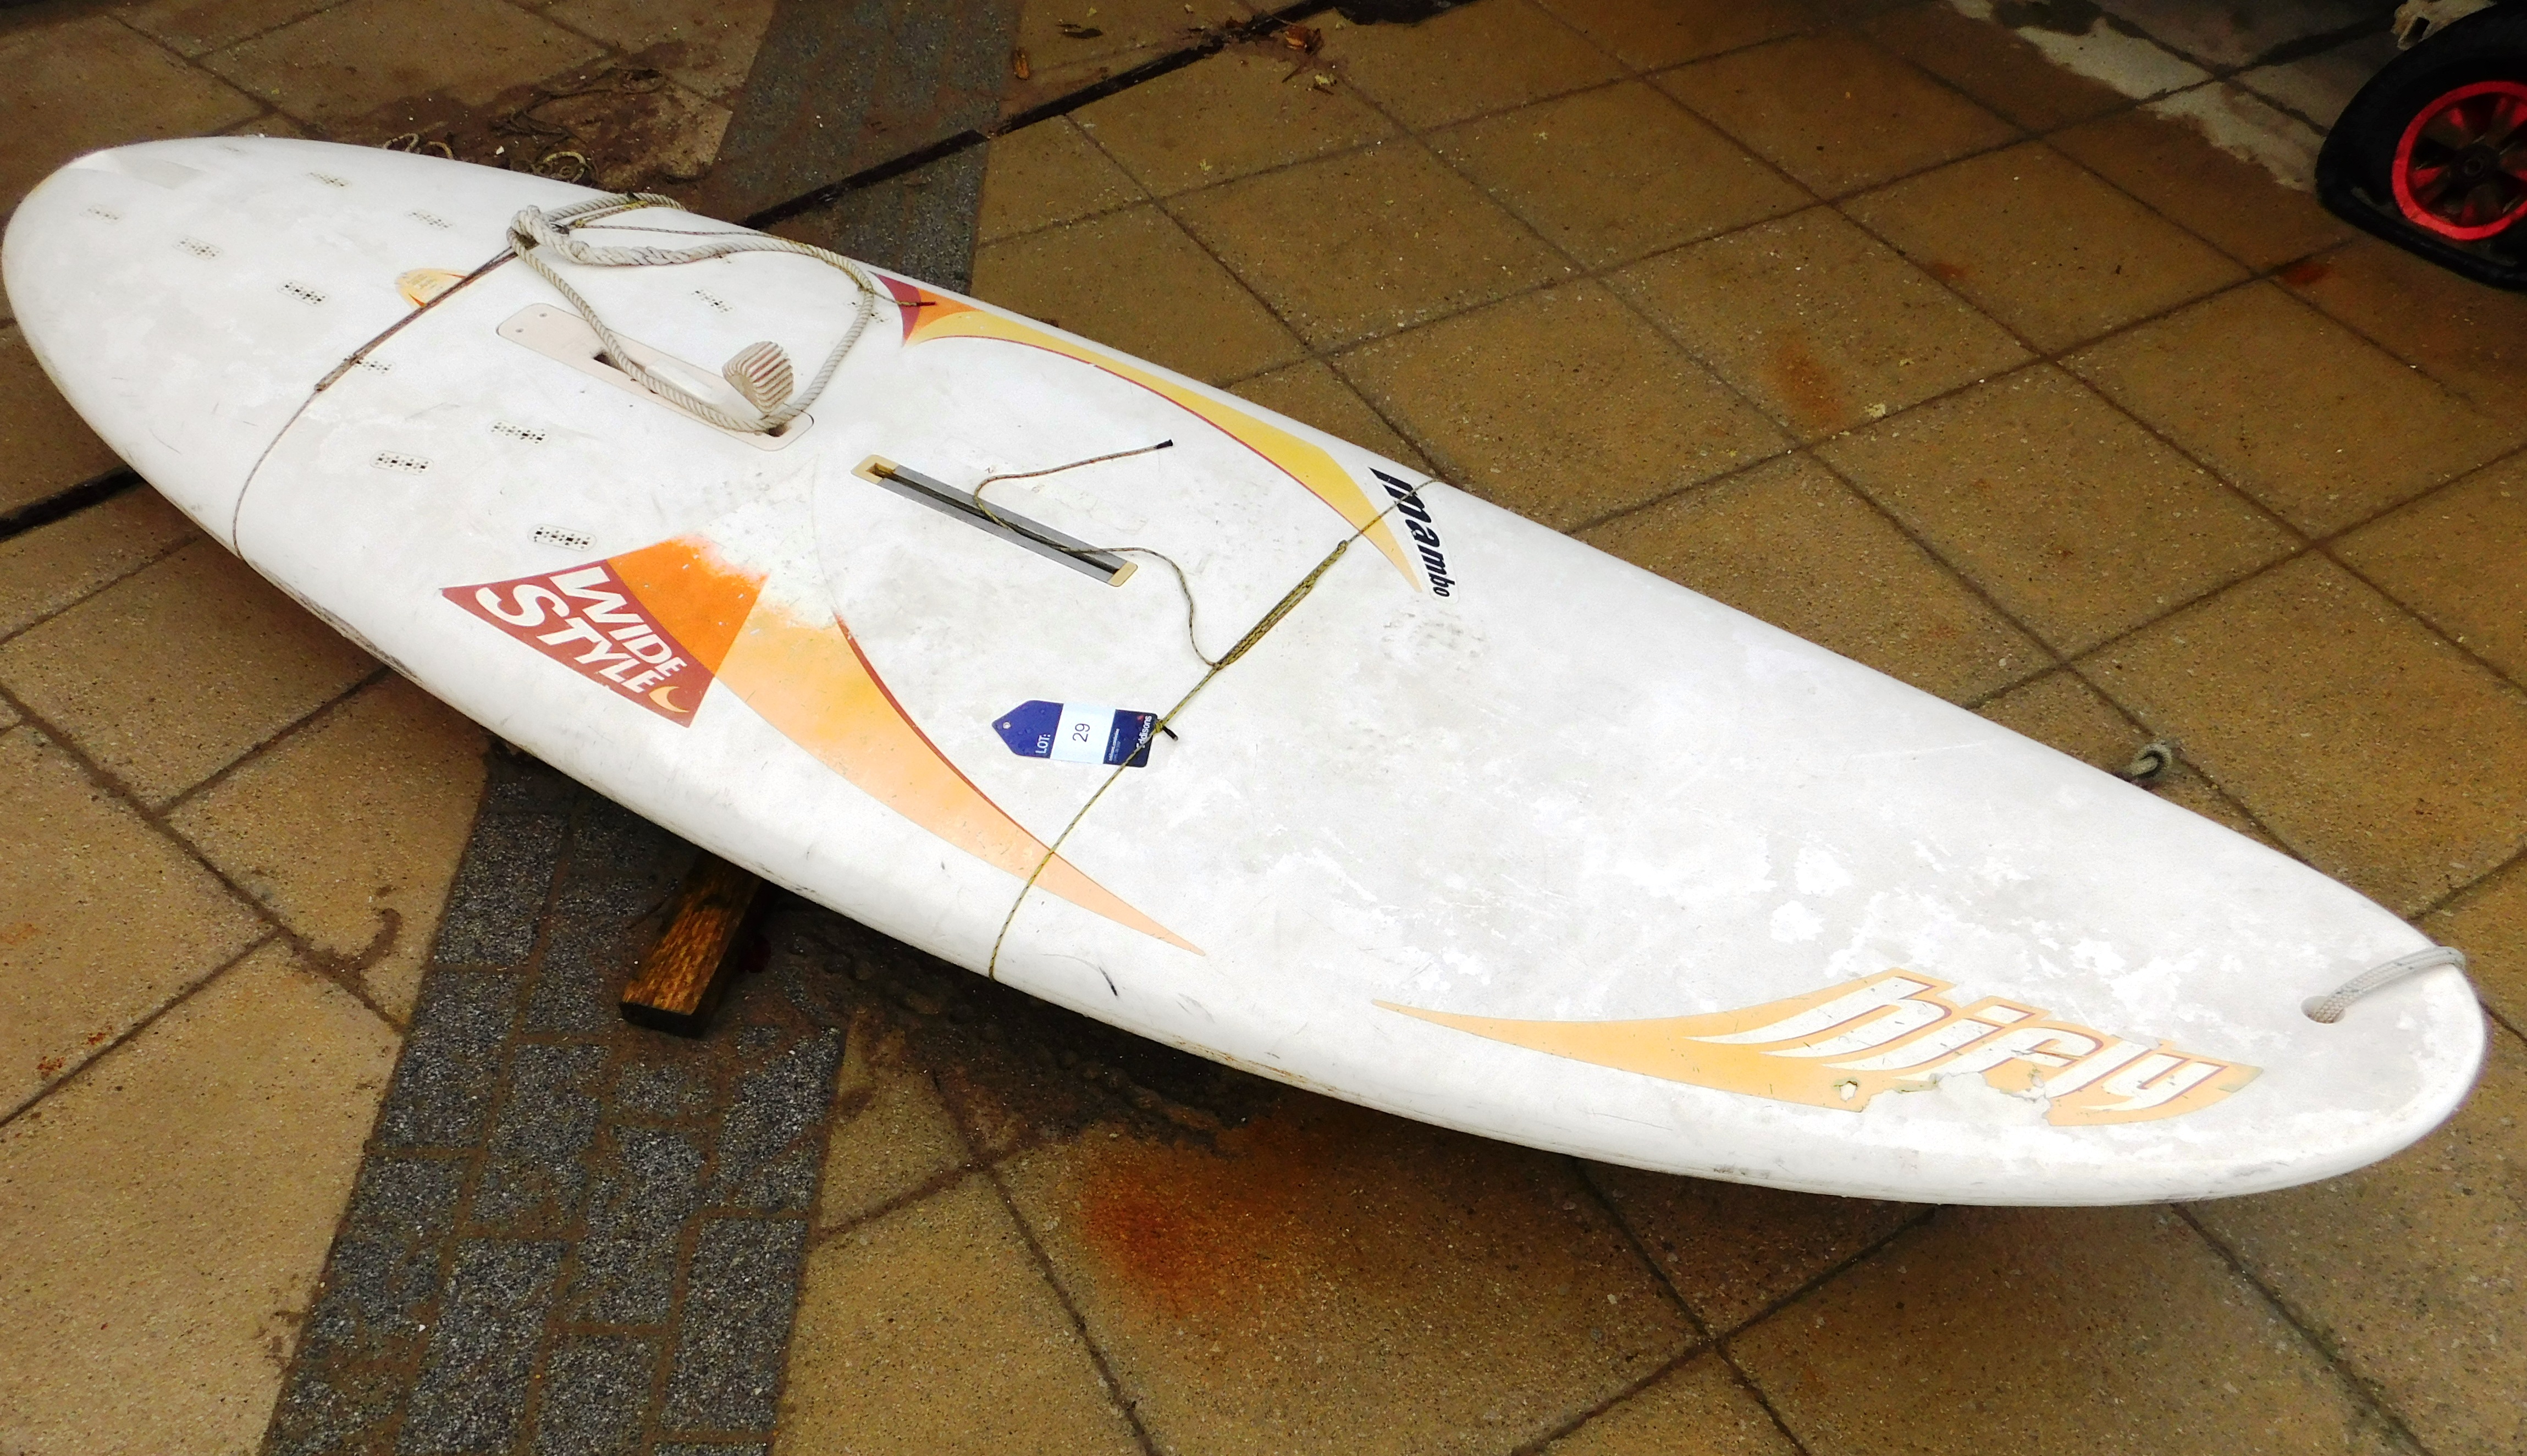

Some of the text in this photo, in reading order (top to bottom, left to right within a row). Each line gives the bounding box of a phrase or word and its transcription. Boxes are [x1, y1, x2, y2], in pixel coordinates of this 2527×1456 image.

[475, 584, 665, 693] STYLE
[549, 566, 687, 677] WIDE
[1035, 733, 1051, 754] LOT:
[1072, 723, 1090, 743] 29
